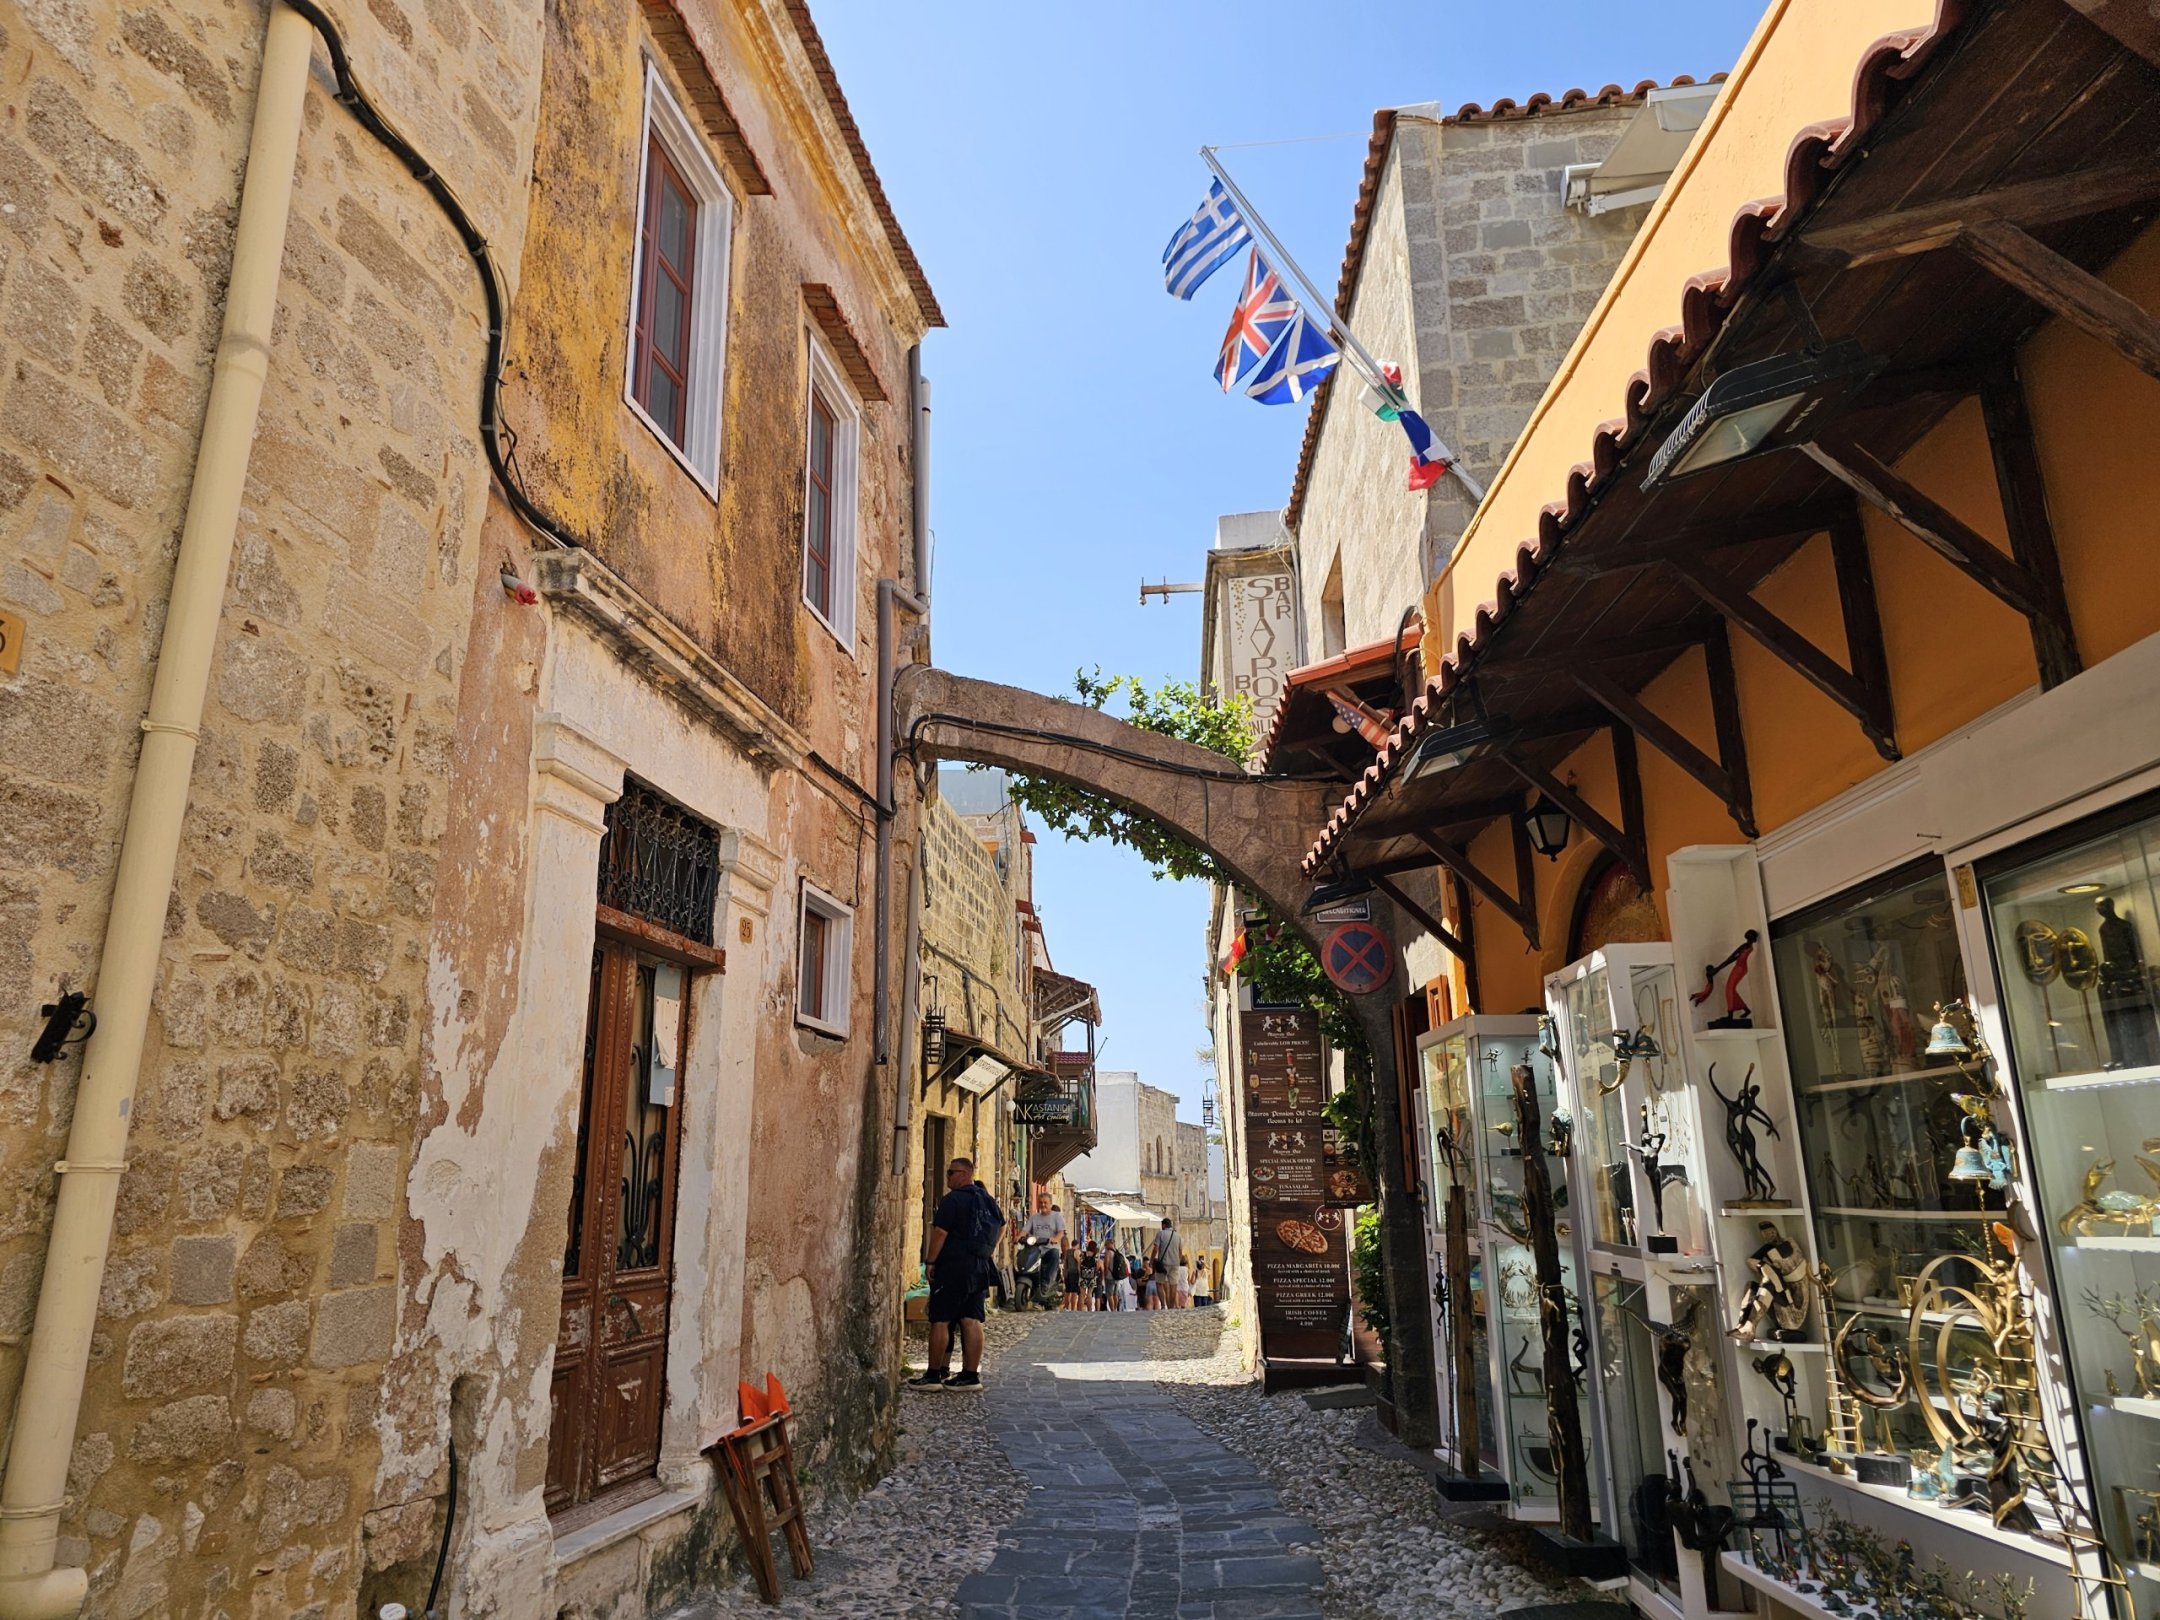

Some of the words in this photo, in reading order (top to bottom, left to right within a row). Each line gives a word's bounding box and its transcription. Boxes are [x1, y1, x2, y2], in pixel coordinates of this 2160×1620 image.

[1274, 576, 1291, 620] BAR
[1247, 578, 1279, 718] STAVROS
[741, 919, 751, 938] 25
